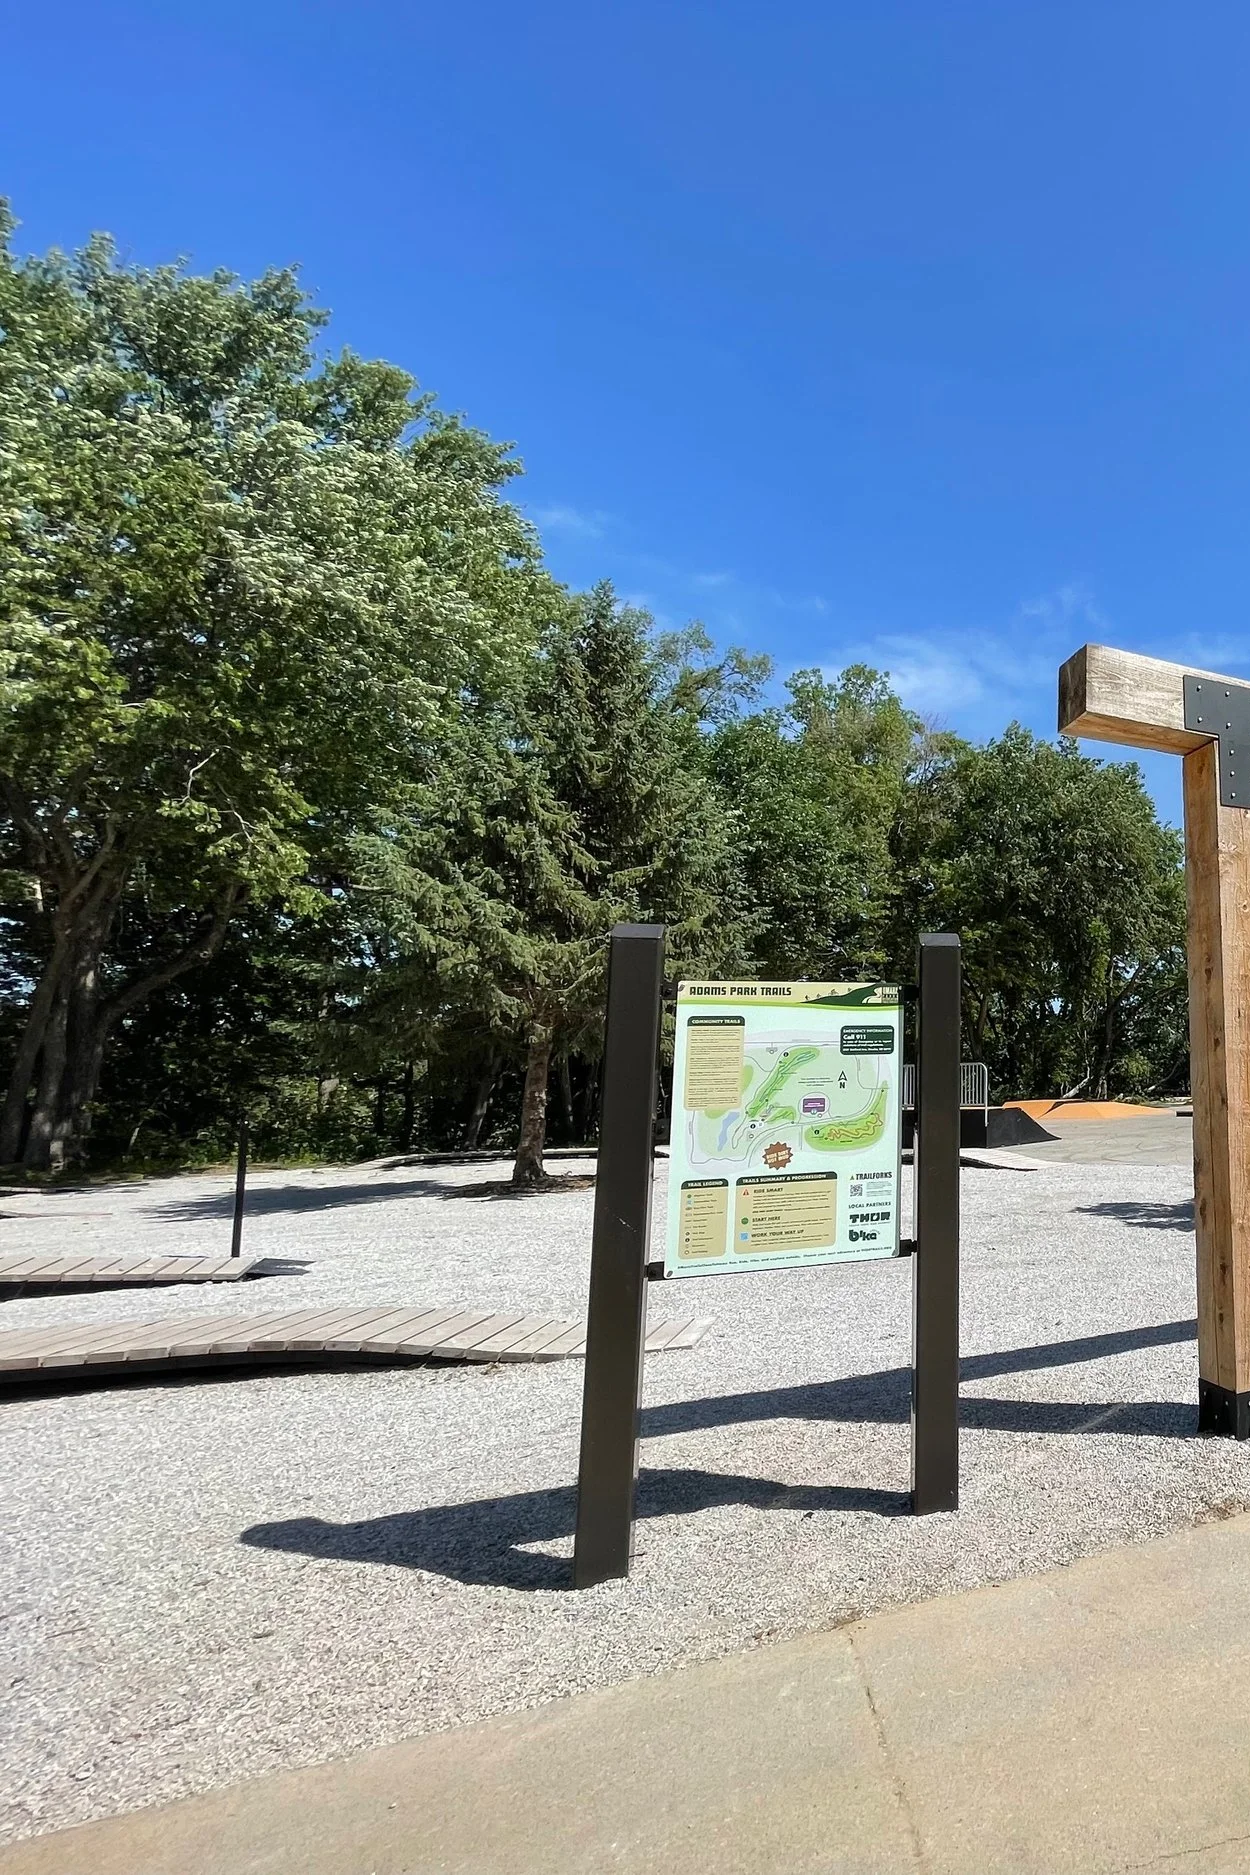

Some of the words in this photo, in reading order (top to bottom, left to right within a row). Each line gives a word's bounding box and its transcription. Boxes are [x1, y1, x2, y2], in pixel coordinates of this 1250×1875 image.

[690, 987, 726, 995] ADAMS
[730, 987, 757, 995] PARK
[760, 987, 791, 995] TRAILS
[856, 1172, 892, 1180] TRAILFORKS
